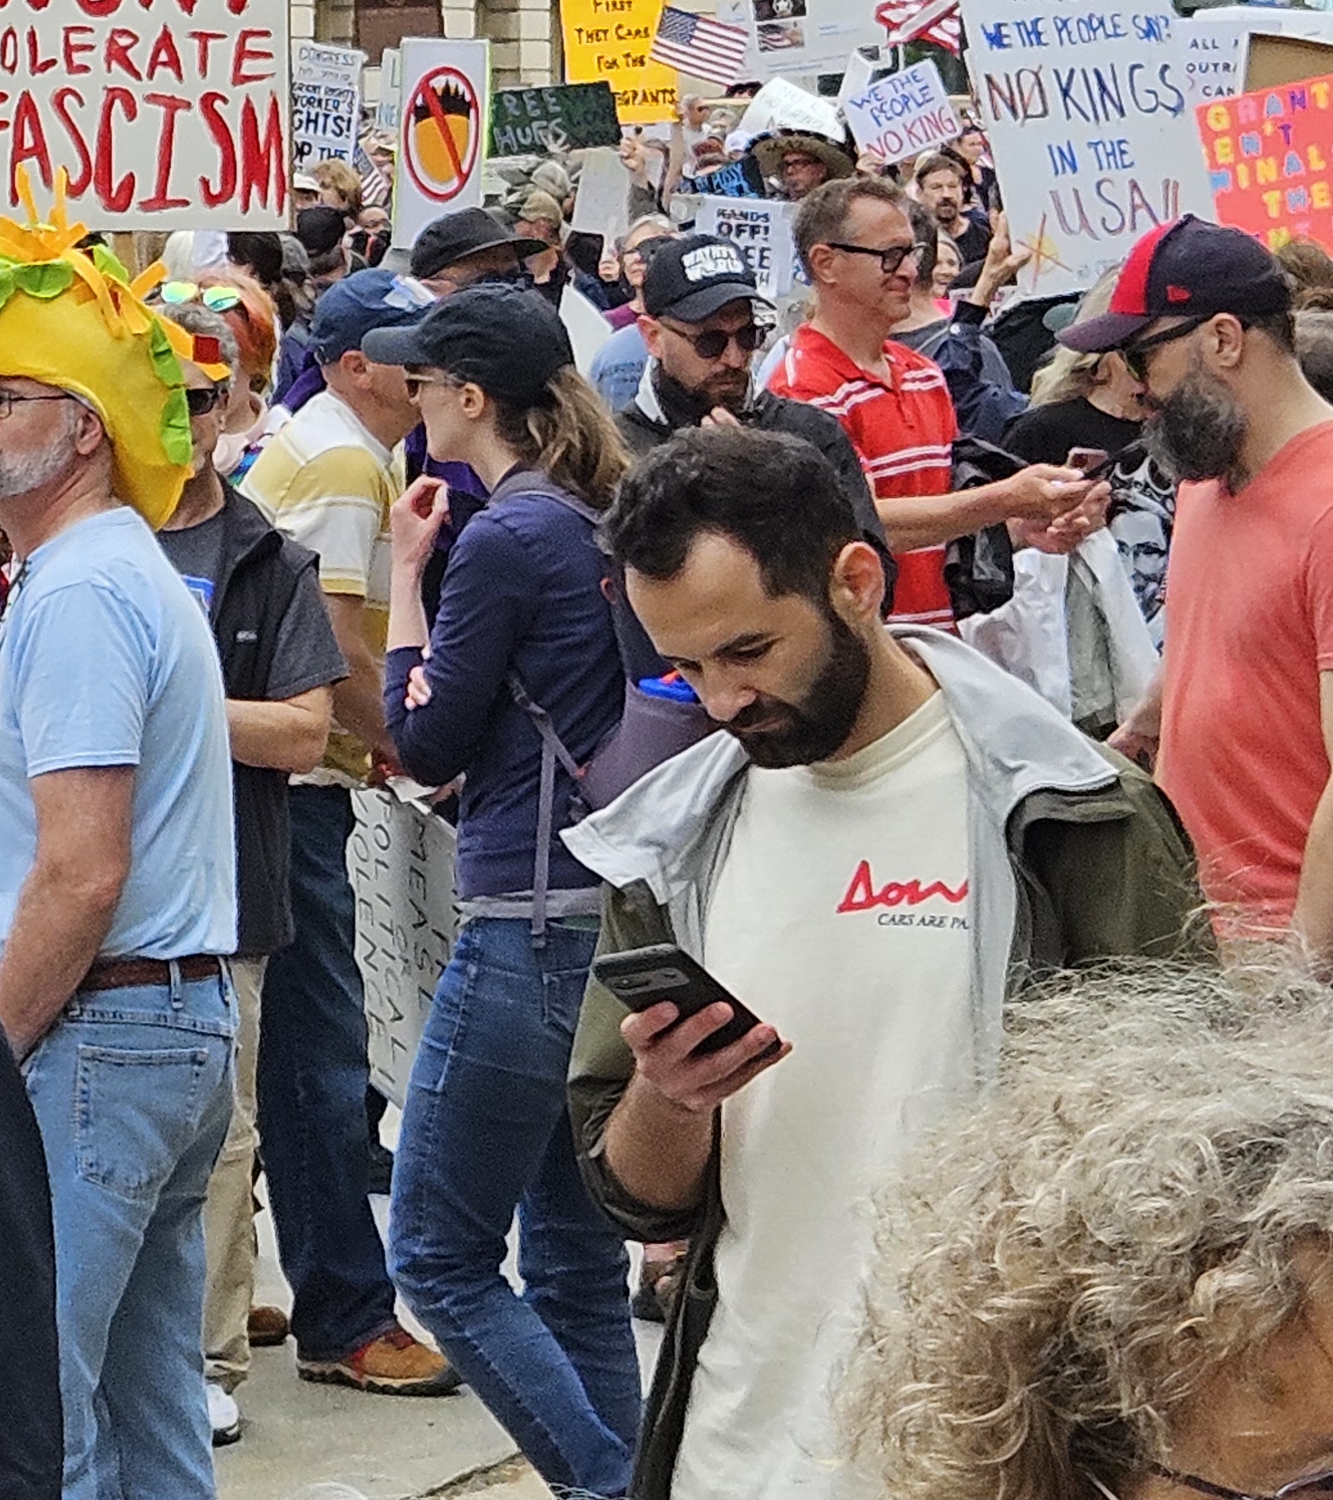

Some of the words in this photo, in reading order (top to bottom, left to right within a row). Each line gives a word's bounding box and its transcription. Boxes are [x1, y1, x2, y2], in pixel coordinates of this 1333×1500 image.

[1012, 17, 1050, 48] THE
[1052, 13, 1128, 47] PEOPLE
[1189, 37, 1221, 51] ALL
[848, 85, 882, 110] WE
[885, 68, 925, 93] THE
[869, 84, 934, 129] PEOPLE
[1052, 62, 1186, 126] KINGS
[864, 130, 903, 160] NO
[900, 106, 958, 151] KING
[1046, 139, 1079, 177] IN
[1086, 138, 1135, 172] THE
[716, 220, 770, 242] OFF!
[373, 791, 409, 1062] POLITICAL
[877, 913, 914, 927] CARS
[917, 914, 947, 929] ARE
